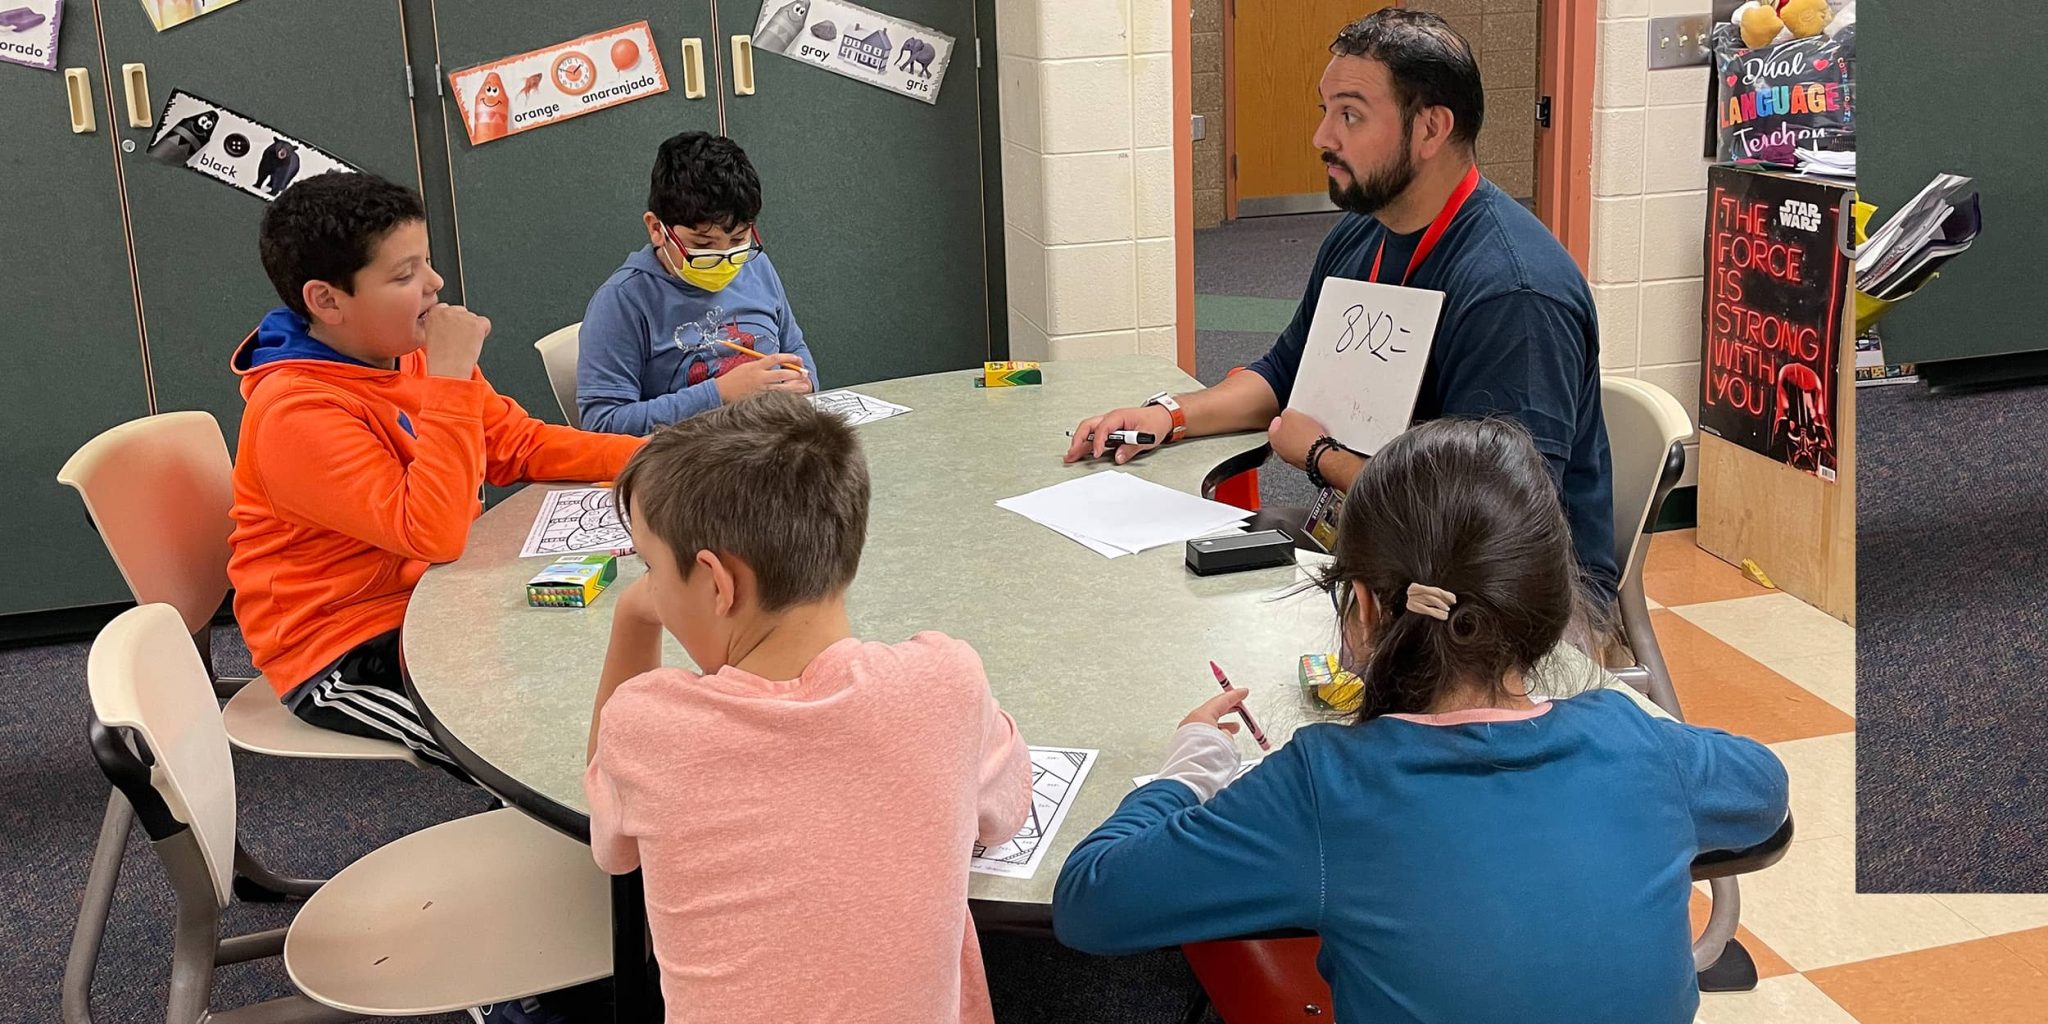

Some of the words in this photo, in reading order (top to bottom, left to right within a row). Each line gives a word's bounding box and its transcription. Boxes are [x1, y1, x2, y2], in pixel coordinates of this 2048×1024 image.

[800, 44, 831, 63] gray
[1742, 52, 1806, 85] Dual
[581, 75, 655, 104] anaranjado
[906, 79, 929, 92] gris
[514, 103, 560, 123] orange
[1720, 81, 1840, 129] LANGUAGE
[200, 153, 237, 178] black
[1721, 197, 1769, 237] THE
[1779, 199, 1822, 219] STAR
[1779, 211, 1821, 232] WARS
[1719, 232, 1803, 282] FORCE
[1717, 267, 1742, 302] IS
[1716, 302, 1819, 361] STRONG
[1714, 336, 1775, 385] WITH
[1713, 371, 1764, 415] YOU
